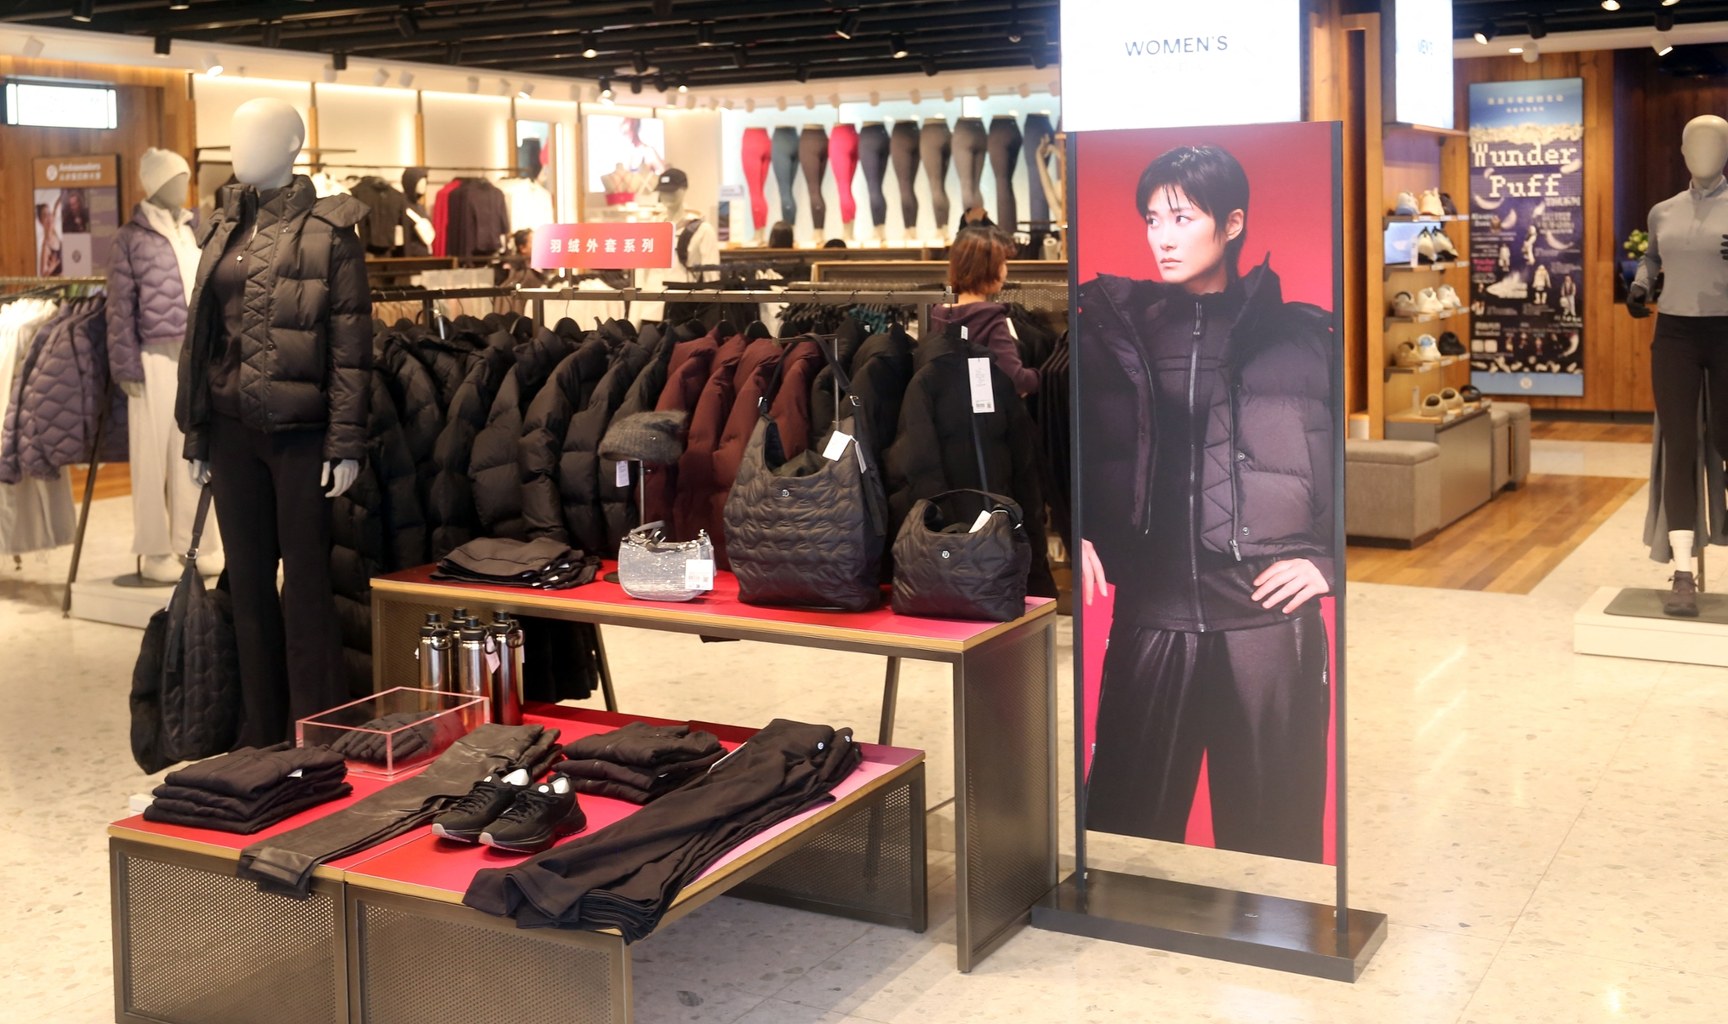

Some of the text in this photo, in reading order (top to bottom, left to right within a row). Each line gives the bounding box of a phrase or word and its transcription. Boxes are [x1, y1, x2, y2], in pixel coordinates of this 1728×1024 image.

[1125, 35, 1228, 56] WOMEN'S
[1472, 140, 1577, 167] Wunder
[1489, 173, 1562, 197] Puff
[550, 238, 654, 253] 羽绒外套系列
